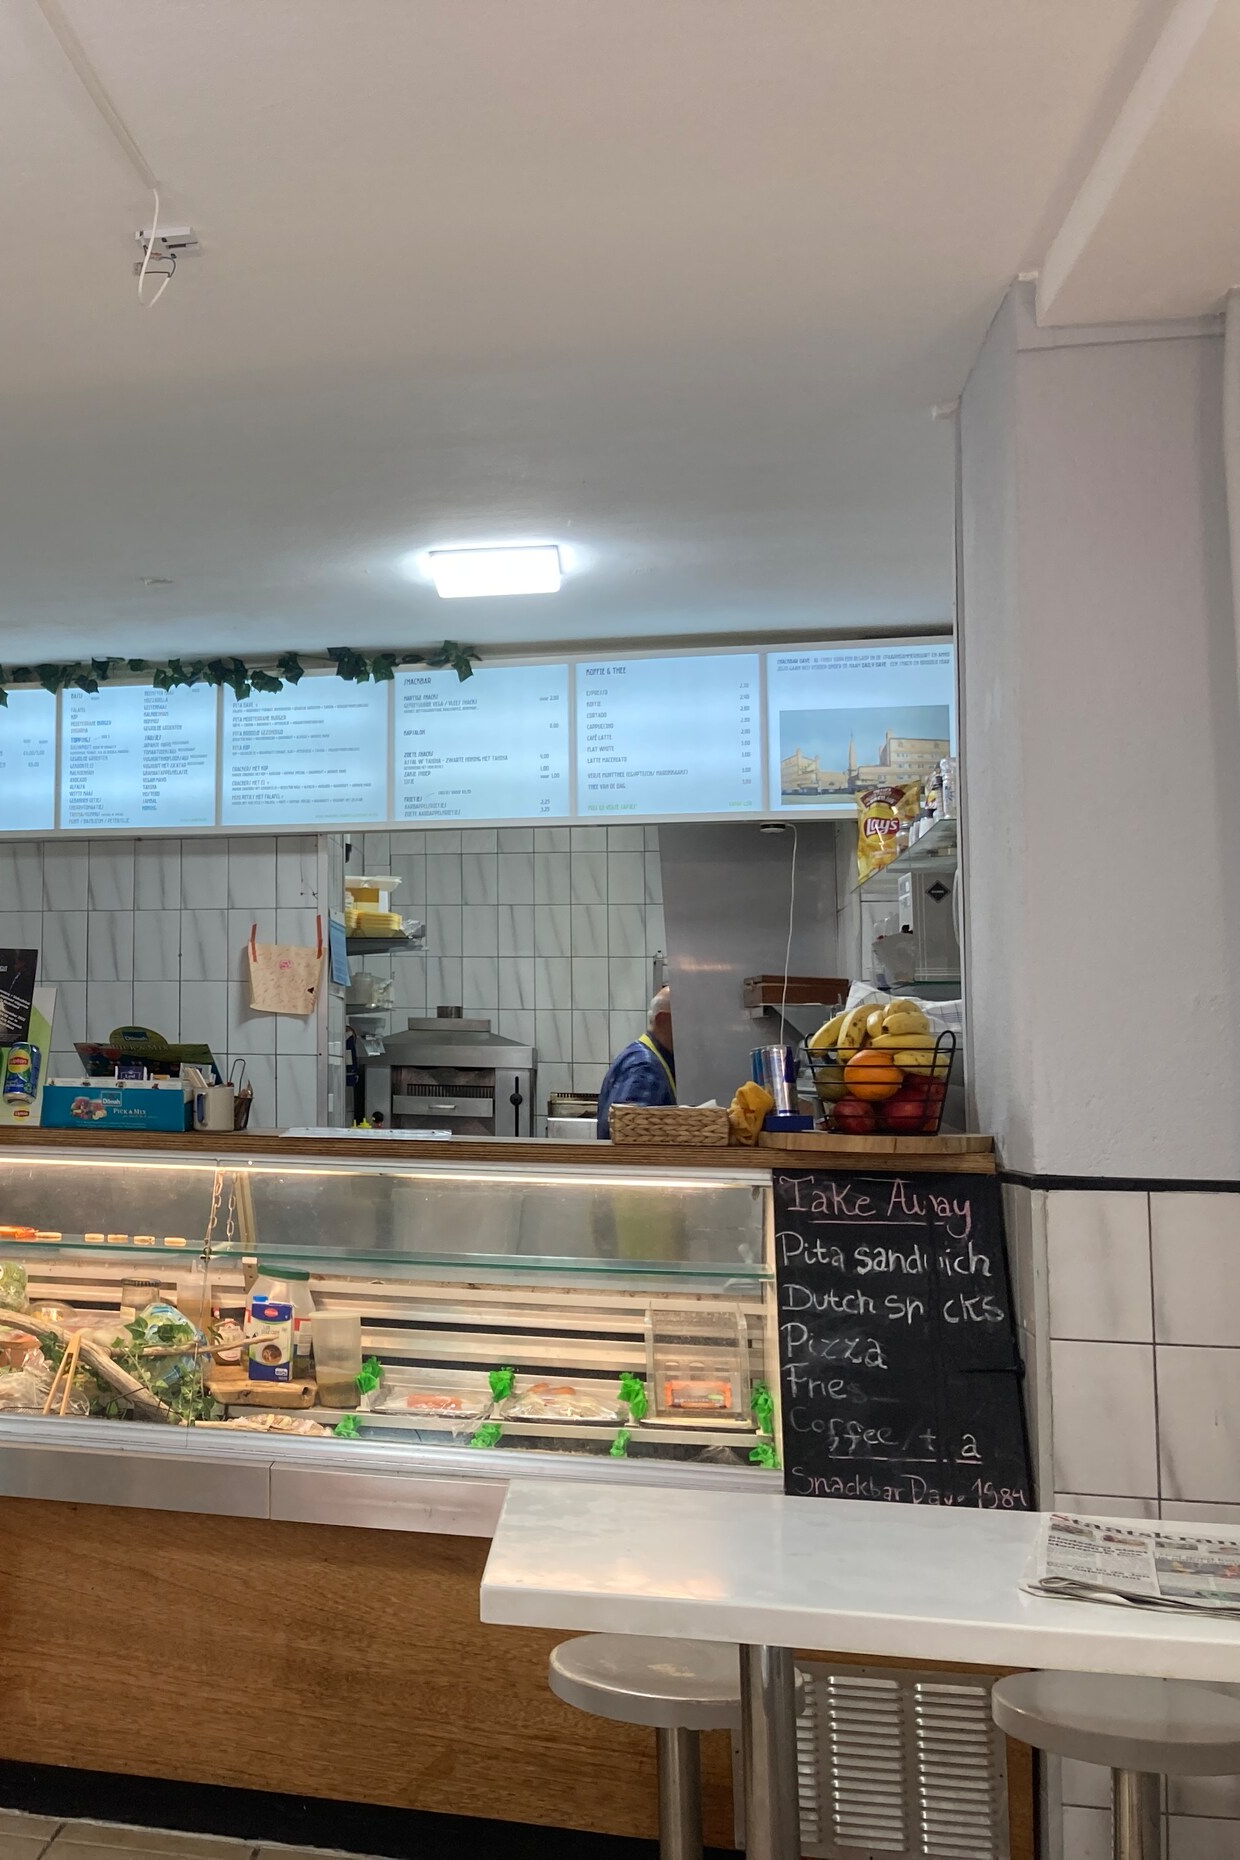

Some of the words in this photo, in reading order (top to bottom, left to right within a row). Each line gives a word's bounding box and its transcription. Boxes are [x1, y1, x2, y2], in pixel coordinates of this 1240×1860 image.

[404, 677, 431, 686] SNACKBAR
[586, 668, 605, 676] KOFFIE
[613, 667, 626, 675] THEE
[865, 817, 898, 836] Lay's
[779, 1176, 877, 1216] Take
[887, 1178, 971, 1239] Away
[776, 1231, 845, 1272] Pita
[782, 1284, 876, 1315] Dutch
[885, 1293, 1005, 1324] sncks
[780, 1322, 888, 1370] Pizza
[918, 1428, 982, 1458] ta
[791, 1466, 901, 1501] Snackbar
[971, 1478, 1029, 1509] 1984
